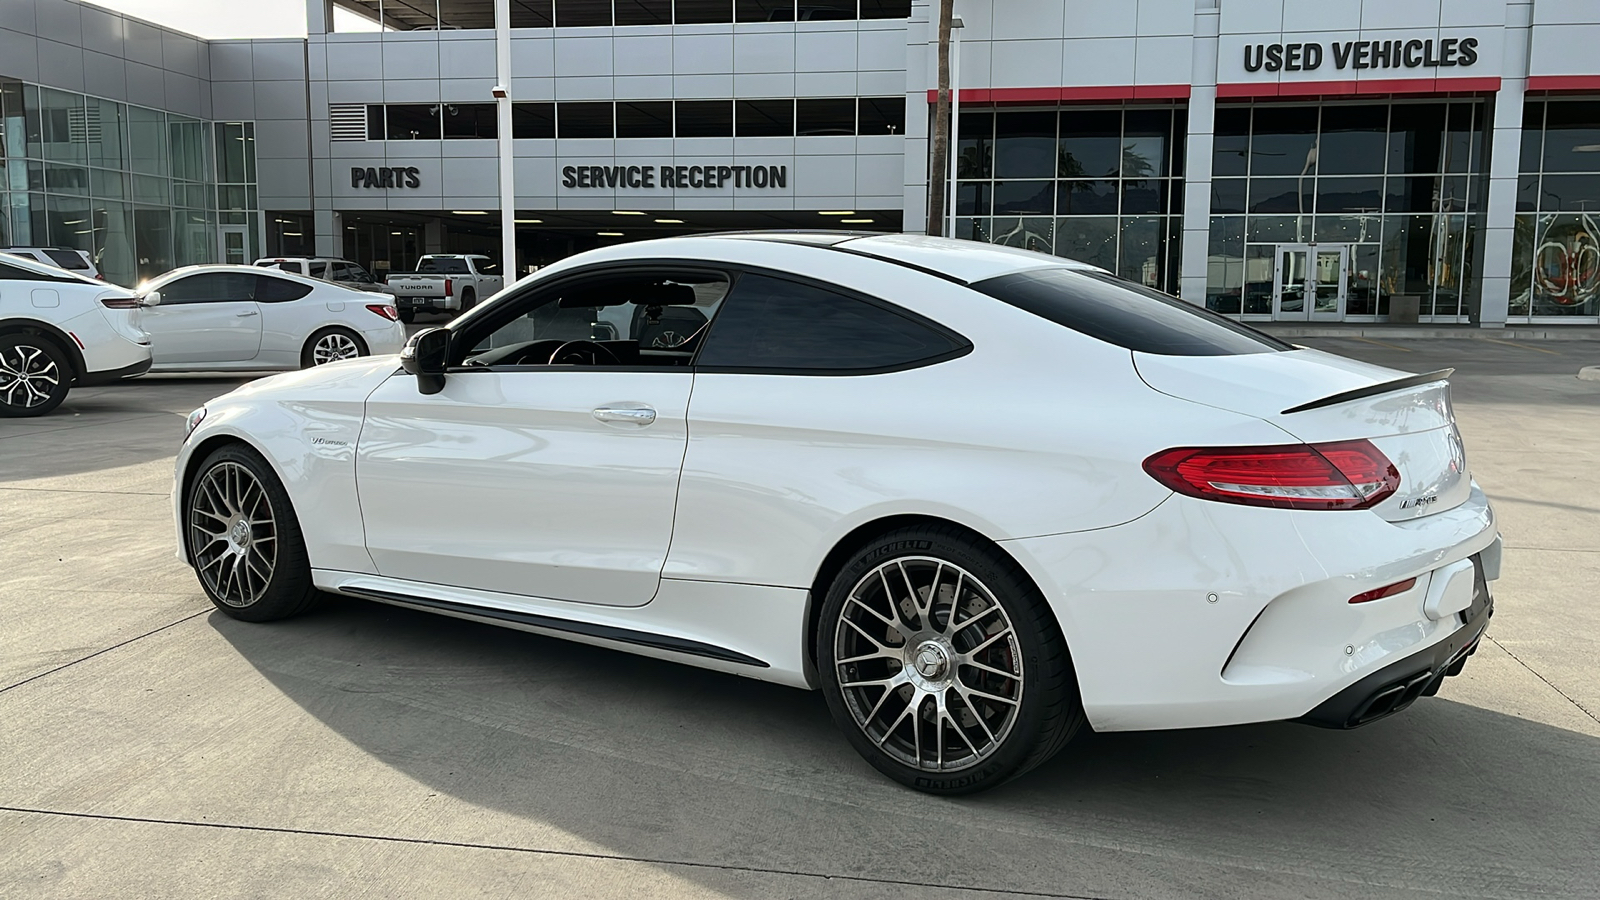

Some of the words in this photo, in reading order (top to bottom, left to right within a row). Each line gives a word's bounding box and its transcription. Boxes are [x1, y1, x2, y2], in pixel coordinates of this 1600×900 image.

[1244, 43, 1323, 72] USED
[1332, 38, 1478, 70] VEHICLES
[351, 166, 420, 188] PARTS
[562, 166, 654, 188] SERVICE
[660, 166, 787, 188] RECEPTION
[865, 540, 929, 562] MICHELIN
